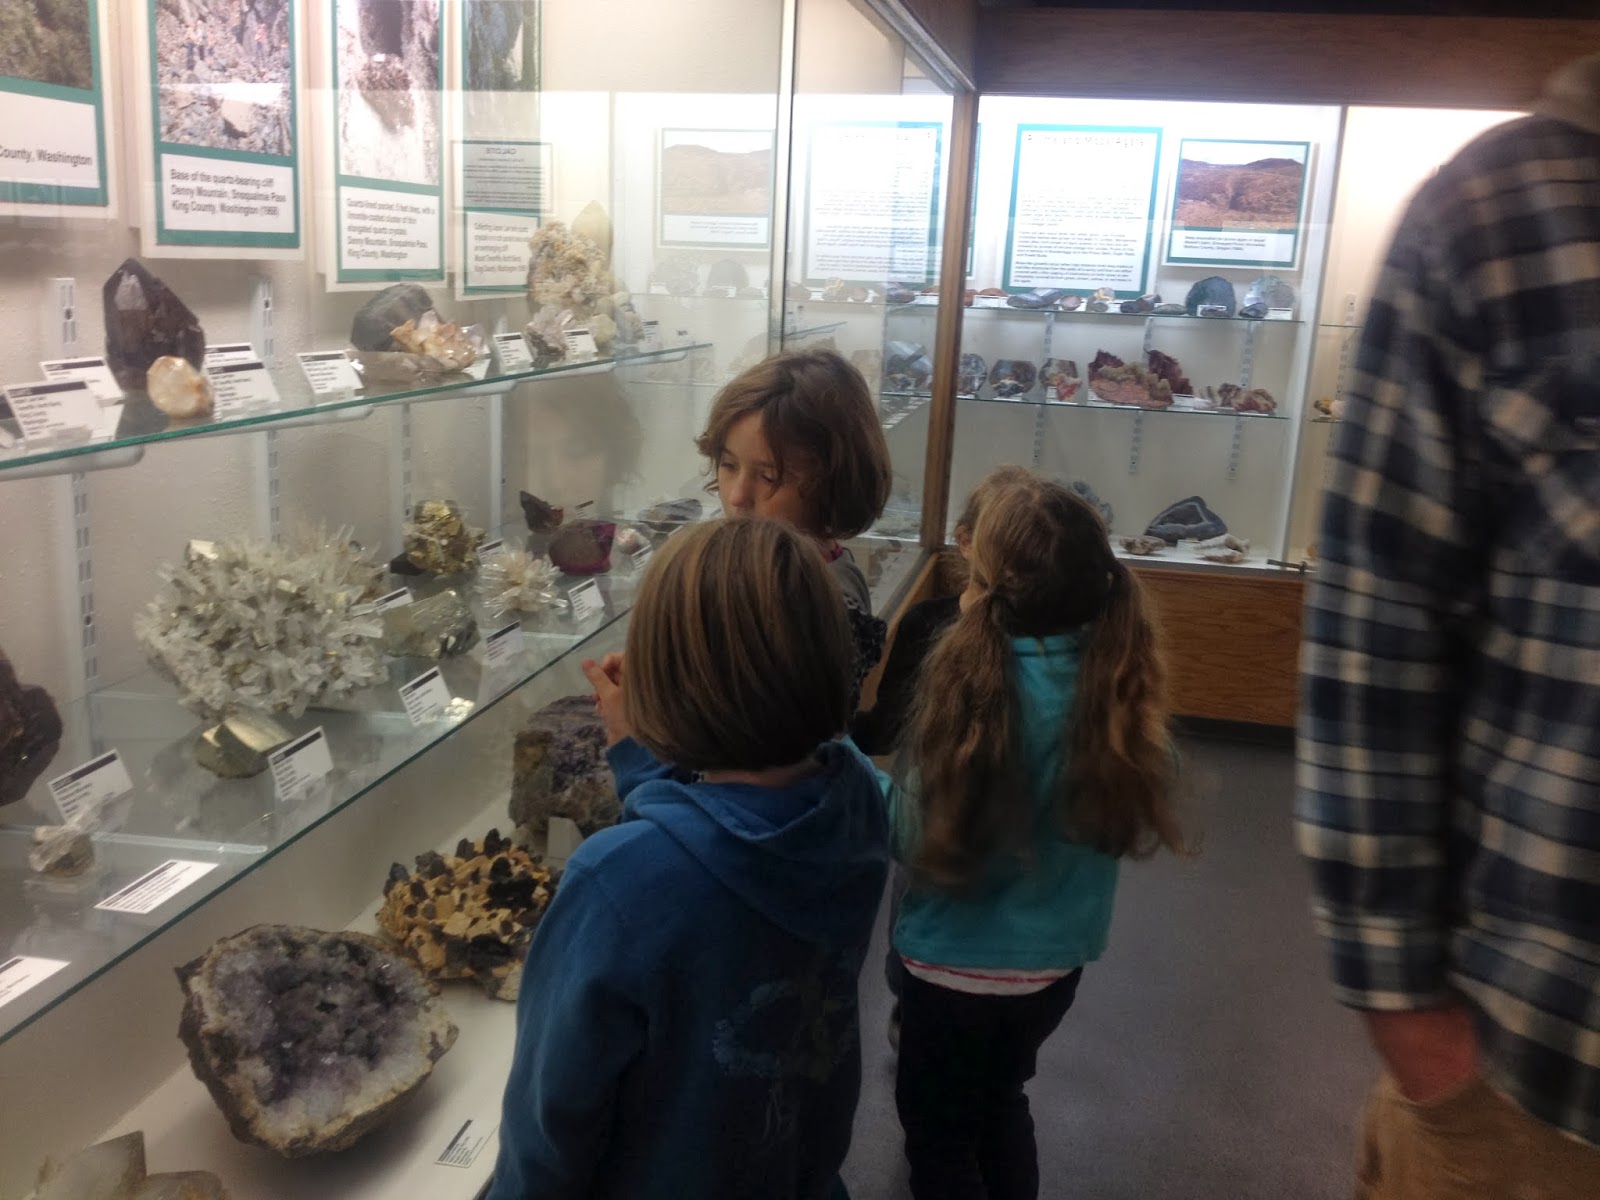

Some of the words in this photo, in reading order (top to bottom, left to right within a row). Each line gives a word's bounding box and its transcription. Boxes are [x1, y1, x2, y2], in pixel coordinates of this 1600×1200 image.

[36, 149, 93, 168] Washington
[170, 168, 190, 180] Base
[191, 171, 199, 181] of
[200, 172, 211, 182] the
[171, 184, 194, 198] Denny
[270, 191, 287, 203] Pass
[171, 200, 189, 214] King
[219, 203, 258, 217] Washington
